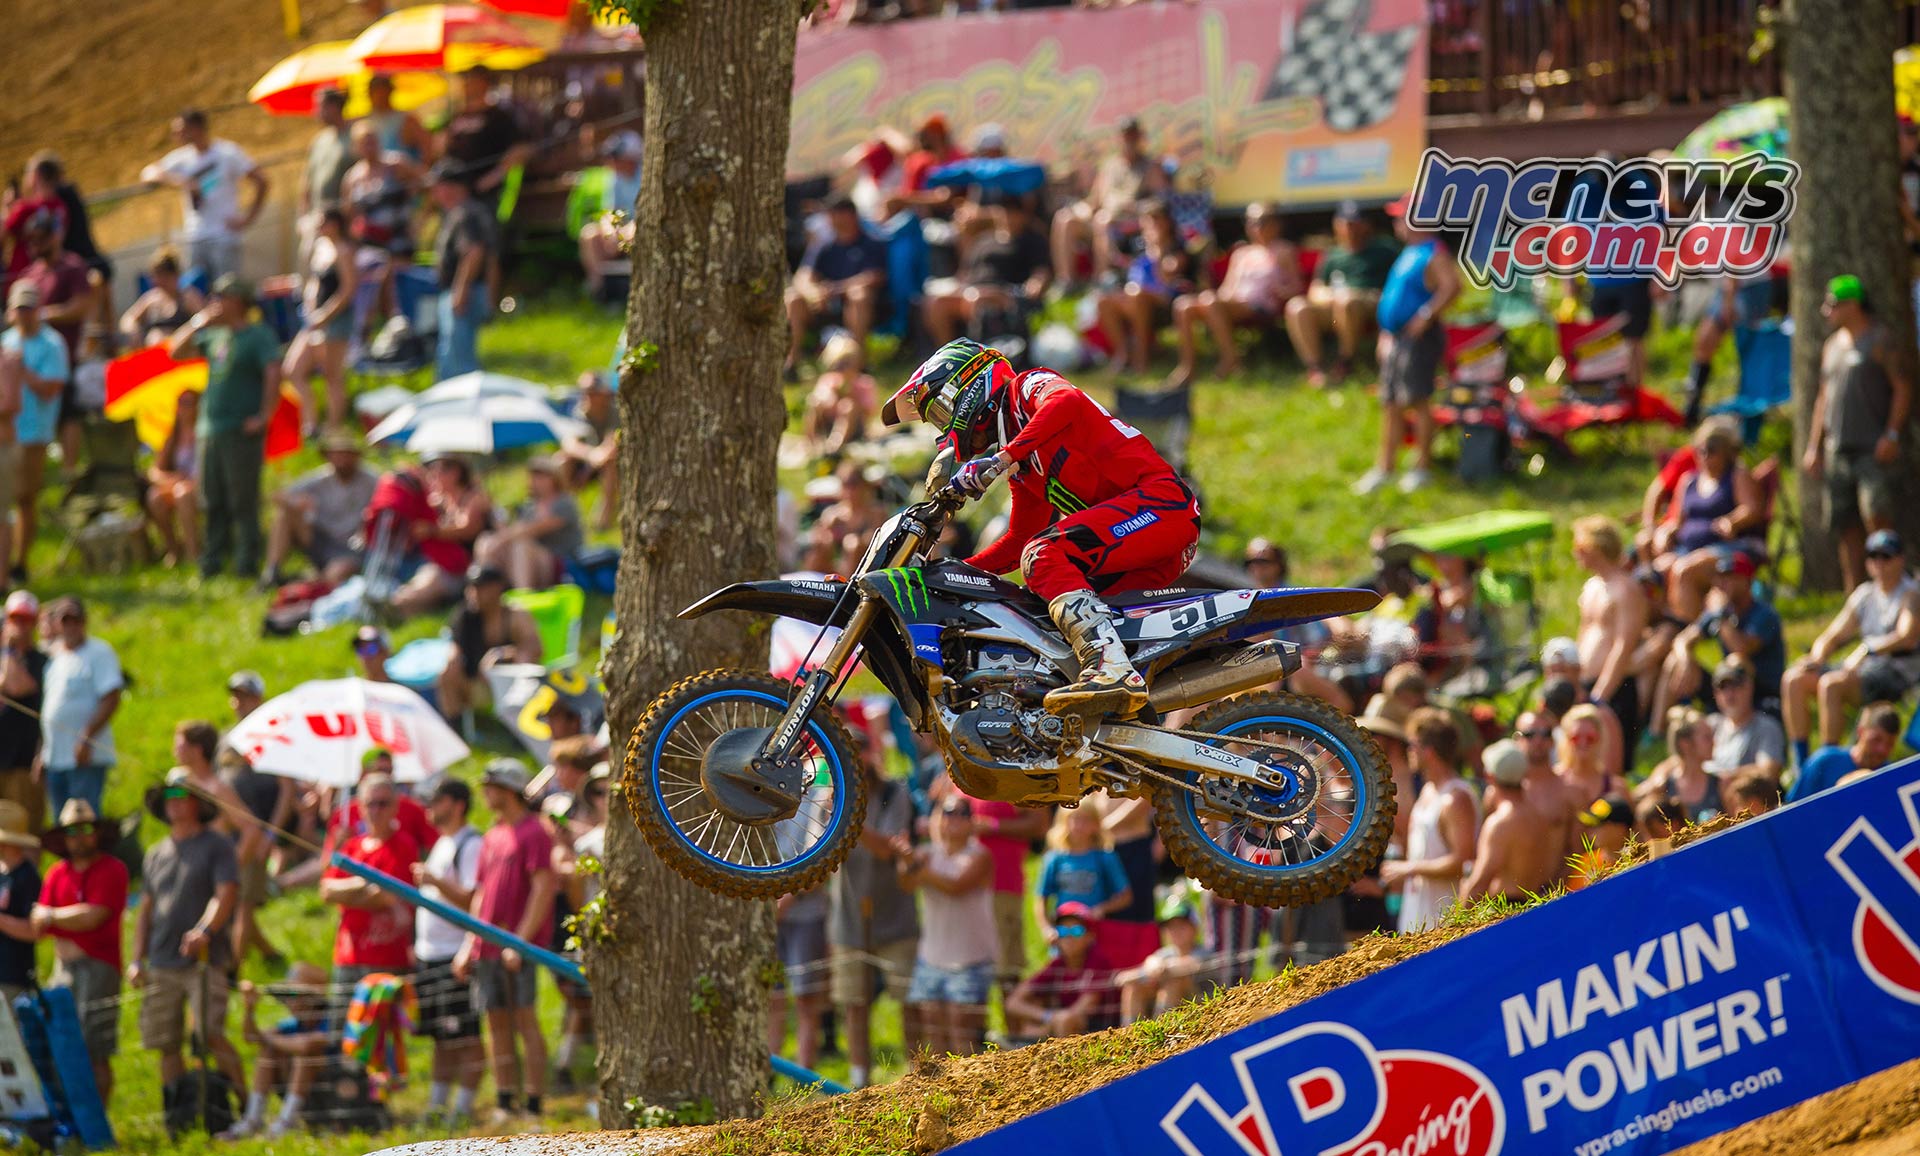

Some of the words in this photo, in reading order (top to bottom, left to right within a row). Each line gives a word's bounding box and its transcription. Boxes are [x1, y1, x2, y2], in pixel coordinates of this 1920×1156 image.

[958, 378, 984, 416] MONSTER
[1121, 512, 1158, 533] YAMAHA
[801, 581, 836, 593] YAMAHA
[944, 572, 992, 587] YAMALUBE
[1152, 587, 1187, 597] YAMAHA
[1169, 597, 1219, 631] 51
[777, 684, 815, 749] DUNLOP
[1195, 743, 1242, 767] VORTEX
[1500, 906, 1750, 1057] MAKIN'
[1522, 977, 1788, 1134] POWER!
